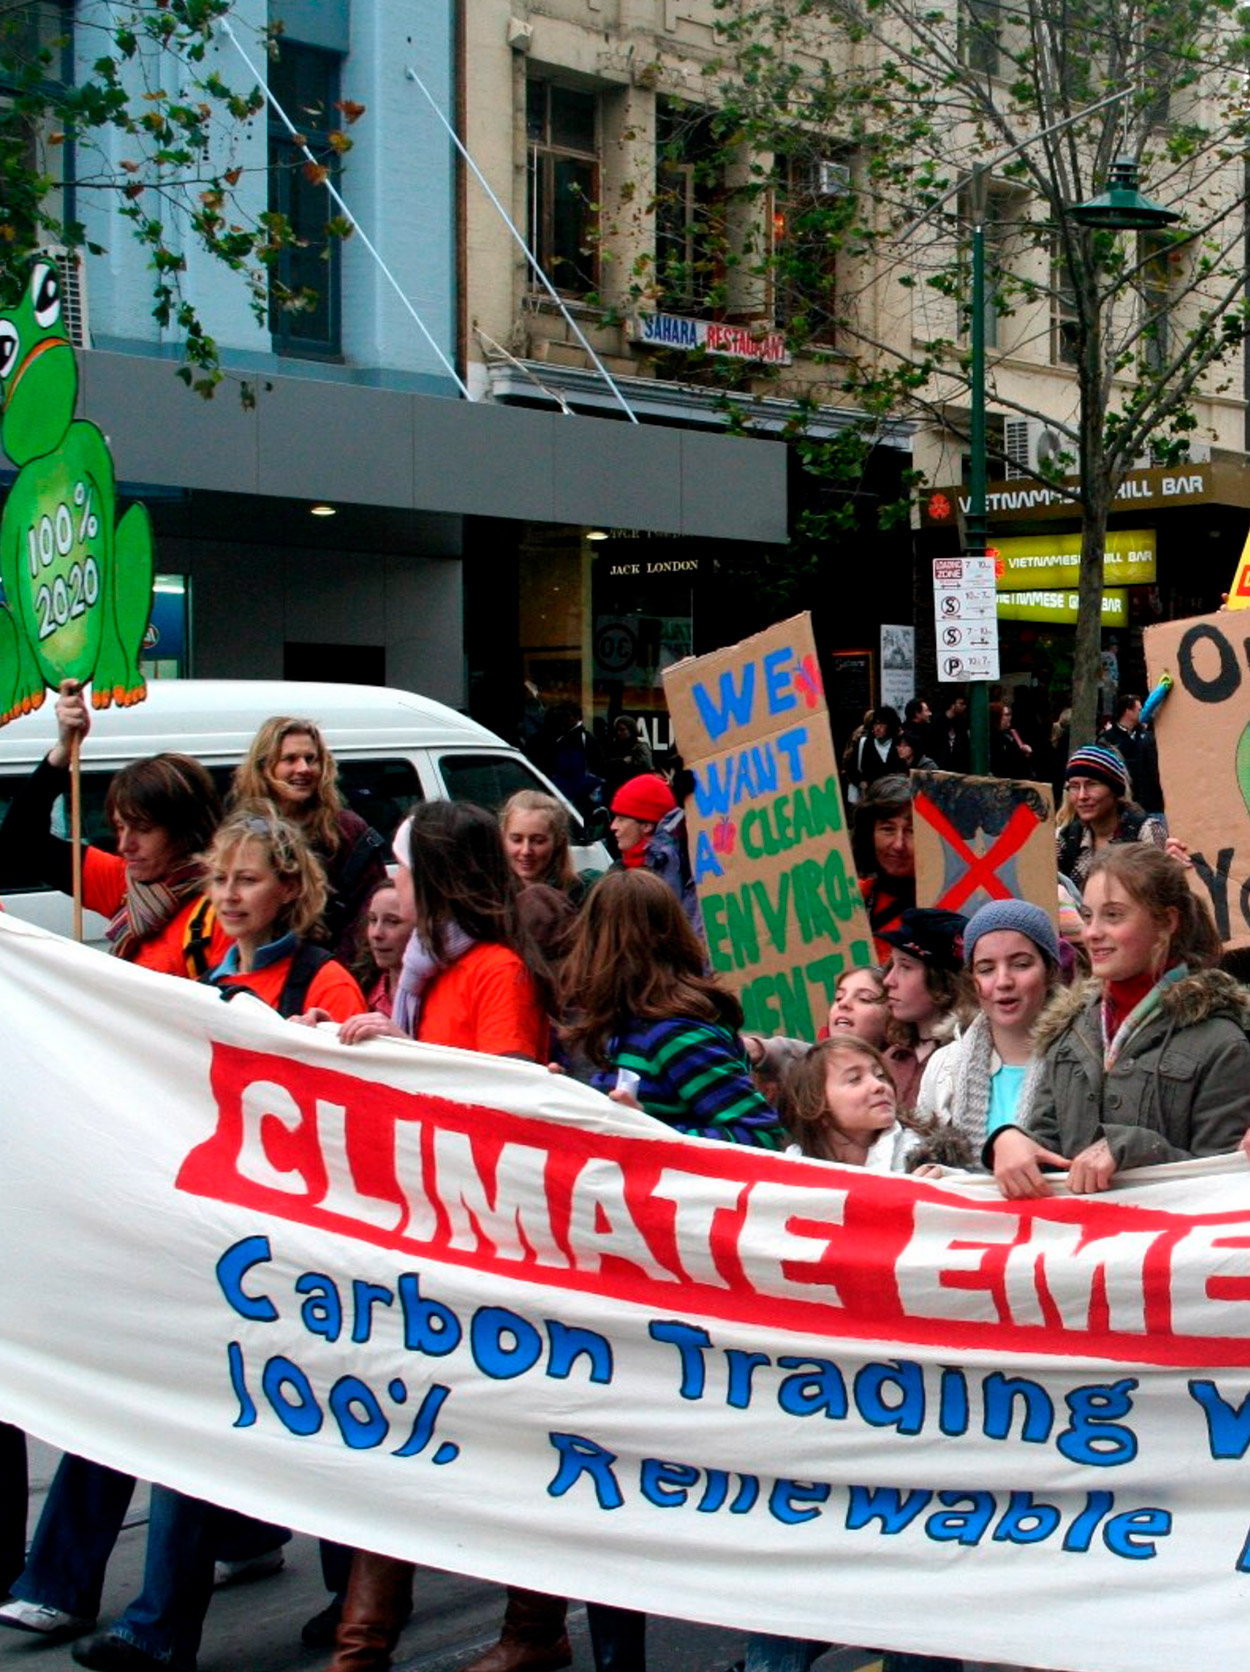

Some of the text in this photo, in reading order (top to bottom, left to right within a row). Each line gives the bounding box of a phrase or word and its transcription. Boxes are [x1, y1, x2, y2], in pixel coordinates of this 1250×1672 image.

[644, 313, 697, 347] SAHARA
[28, 481, 98, 580] 100%
[1162, 476, 1204, 496] BAR
[35, 555, 99, 641] 2020
[610, 560, 699, 575] JACK LONDON
[937, 569, 961, 578] ZONE
[1127, 550, 1152, 562] BAR
[1101, 597, 1122, 613] BAR
[691, 646, 798, 743] WE
[692, 726, 809, 819] WANT
[695, 773, 842, 885] A CLEAN
[236, 1081, 849, 1308] CLIMATE
[215, 1235, 613, 1385] Carbon
[648, 1319, 1139, 1466] Trading
[228, 1341, 460, 1465] 100%
[547, 1432, 1173, 1559] Renewable
